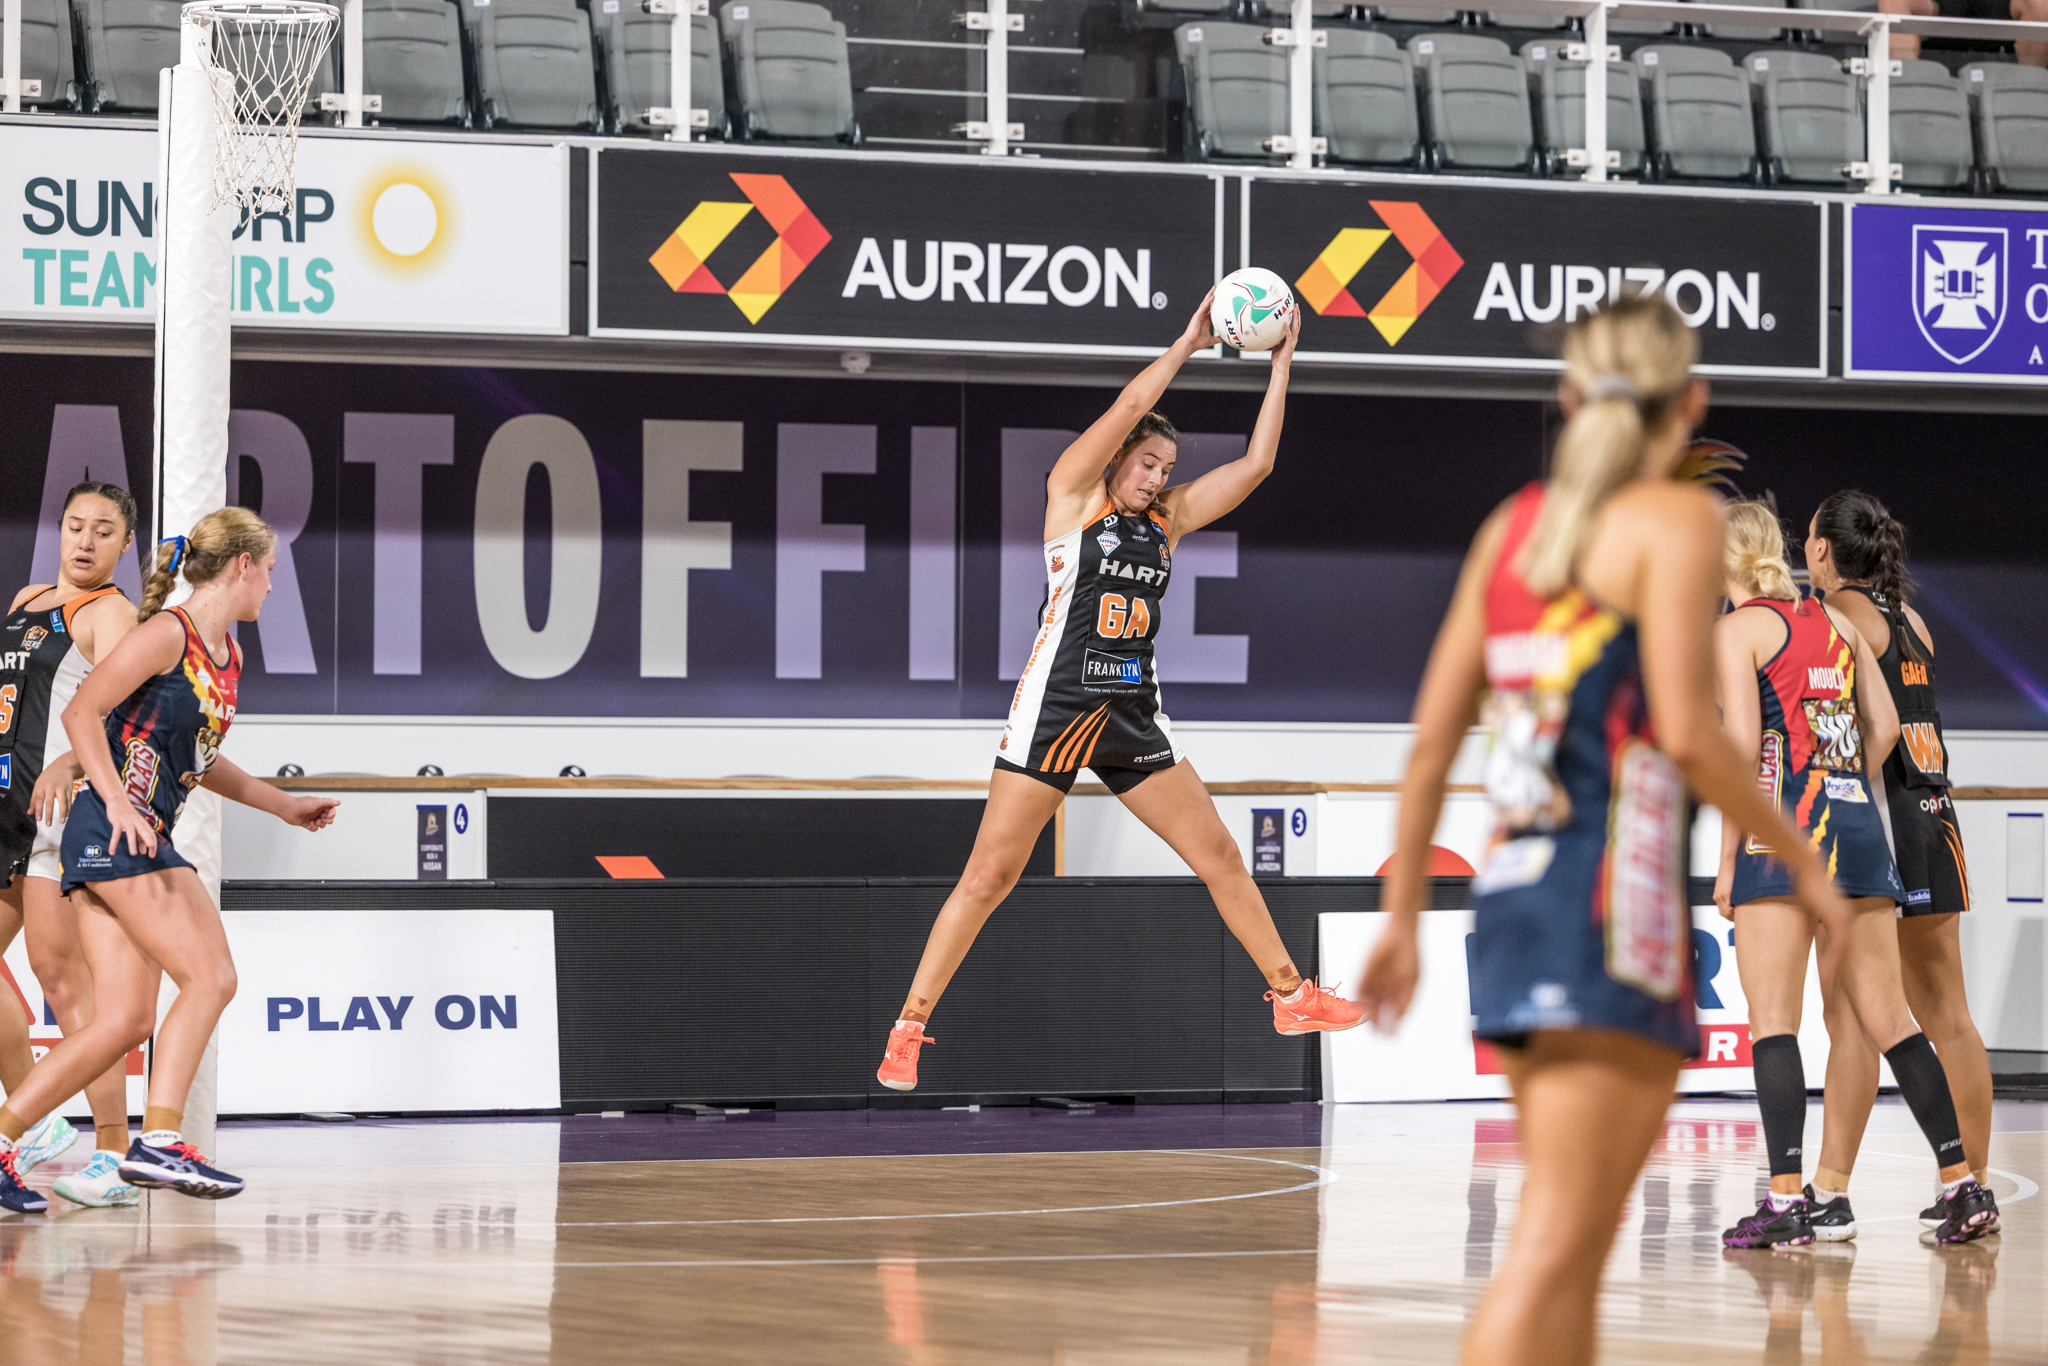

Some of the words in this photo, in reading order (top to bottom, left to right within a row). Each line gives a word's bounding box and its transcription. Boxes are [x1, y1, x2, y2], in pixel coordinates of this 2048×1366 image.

[22, 176, 335, 243] SUNRP
[1099, 558, 1168, 587] HART
[1097, 592, 1151, 639] GA
[1087, 660, 1139, 677] FRANKLYN
[1808, 666, 1845, 690] MOULD
[198, 696, 237, 723] HAR
[1900, 722, 1944, 775] WA
[456, 807, 466, 830] 4
[1294, 811, 1305, 834] 3
[422, 861, 442, 871] NISSAN
[266, 995, 415, 1032] PLAY
[434, 993, 518, 1031] ON
